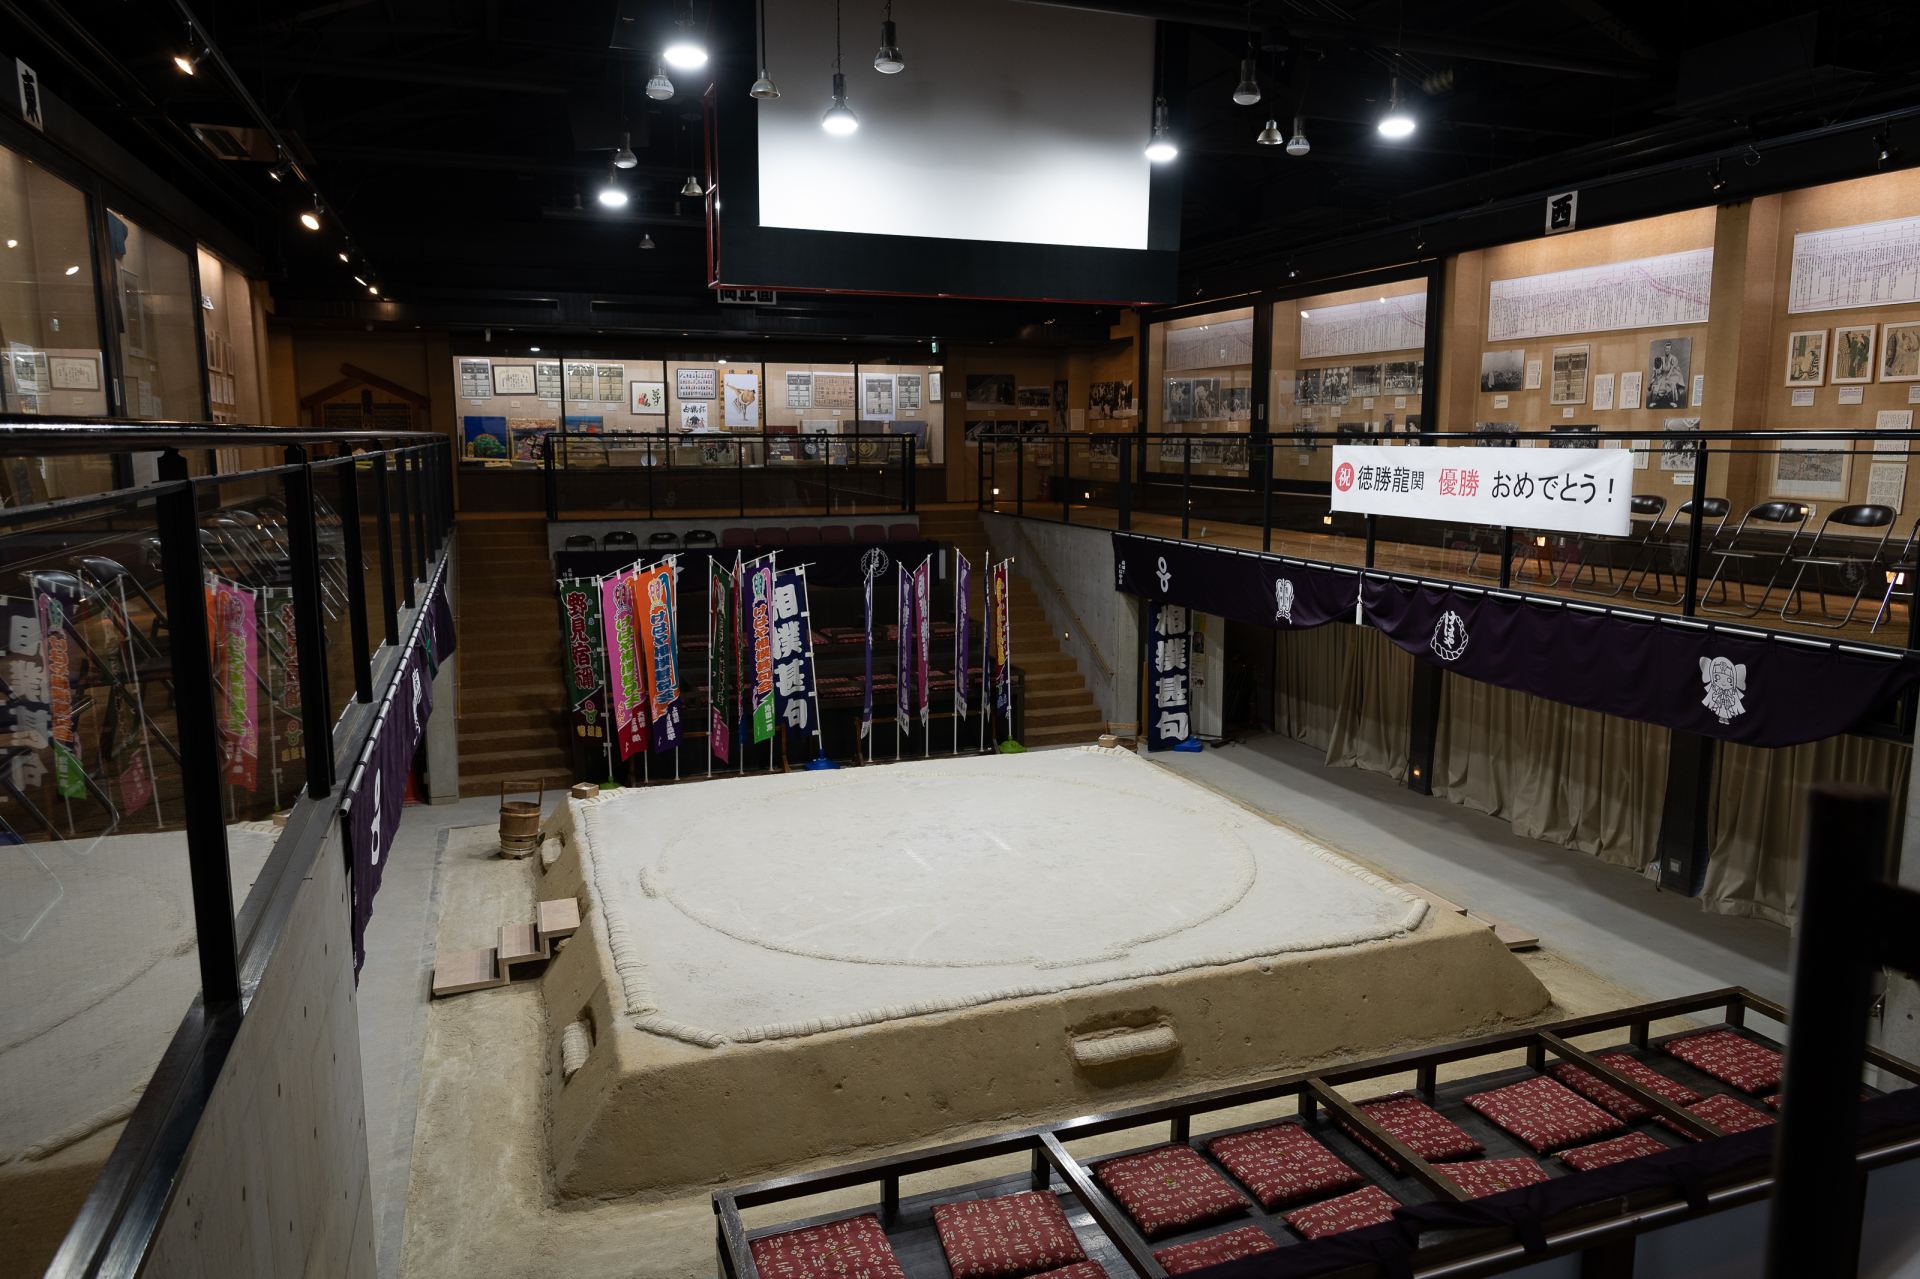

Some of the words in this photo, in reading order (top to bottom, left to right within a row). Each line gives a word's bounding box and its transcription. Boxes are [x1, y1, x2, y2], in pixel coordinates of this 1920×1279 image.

[1552, 193, 1573, 229] 西
[1357, 464, 1425, 493] 徳勝龍関
[1438, 467, 1480, 497] 優勝
[772, 583, 809, 730] 相撲甚句
[1155, 604, 1190, 741] 相撲甚句
